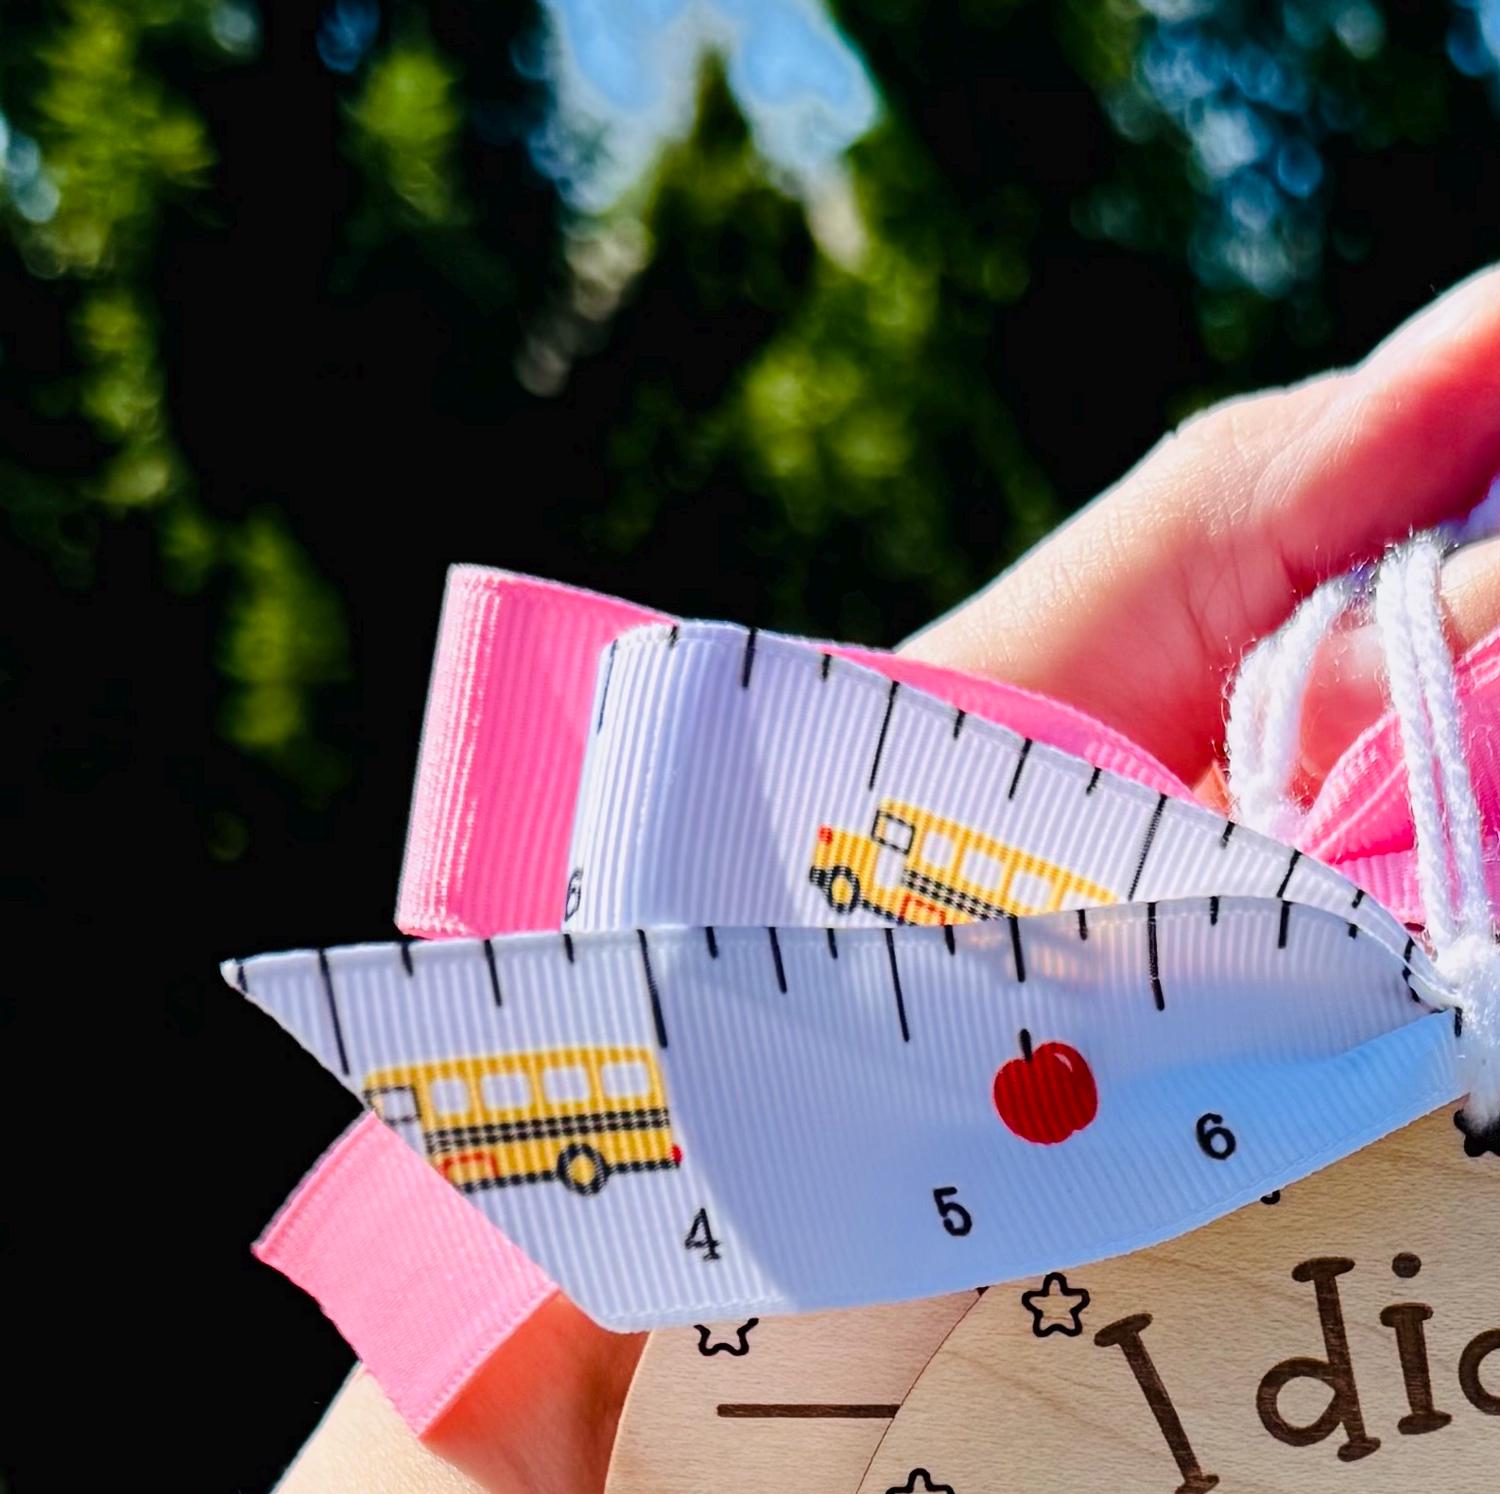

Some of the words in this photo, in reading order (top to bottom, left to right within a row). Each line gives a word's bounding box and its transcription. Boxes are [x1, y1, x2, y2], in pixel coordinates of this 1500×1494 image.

[684, 1207, 722, 1261] 4
[933, 1186, 972, 1237] 5
[1196, 1112, 1237, 1160] 6
